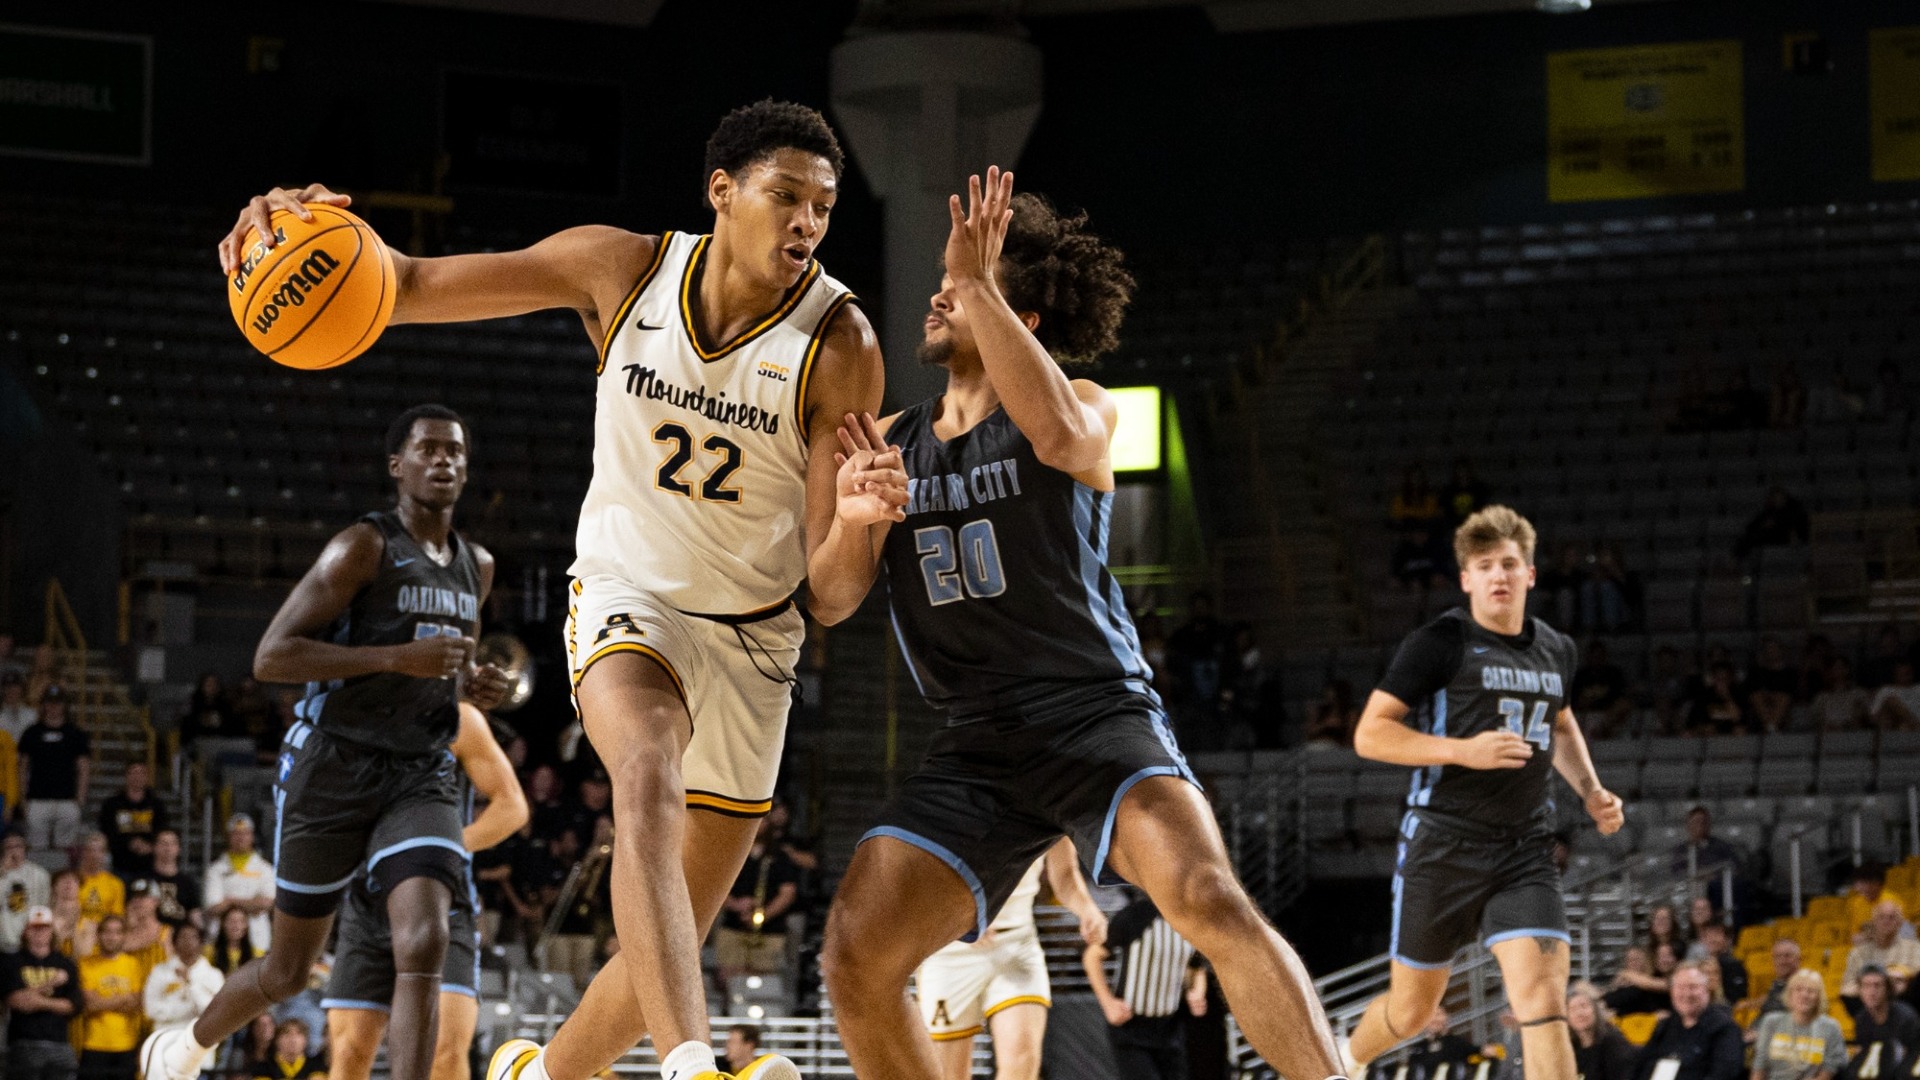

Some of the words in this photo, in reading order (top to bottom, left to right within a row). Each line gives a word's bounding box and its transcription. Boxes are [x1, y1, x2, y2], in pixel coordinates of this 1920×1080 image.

[252, 249, 340, 334] Wilson
[622, 363, 779, 435] Mountaineers
[757, 361, 790, 382] SBC
[651, 419, 745, 505] 22
[970, 458, 1022, 504] CITY
[913, 518, 1007, 606] 20
[1498, 698, 1551, 751] 34
[931, 999, 952, 1027] A
